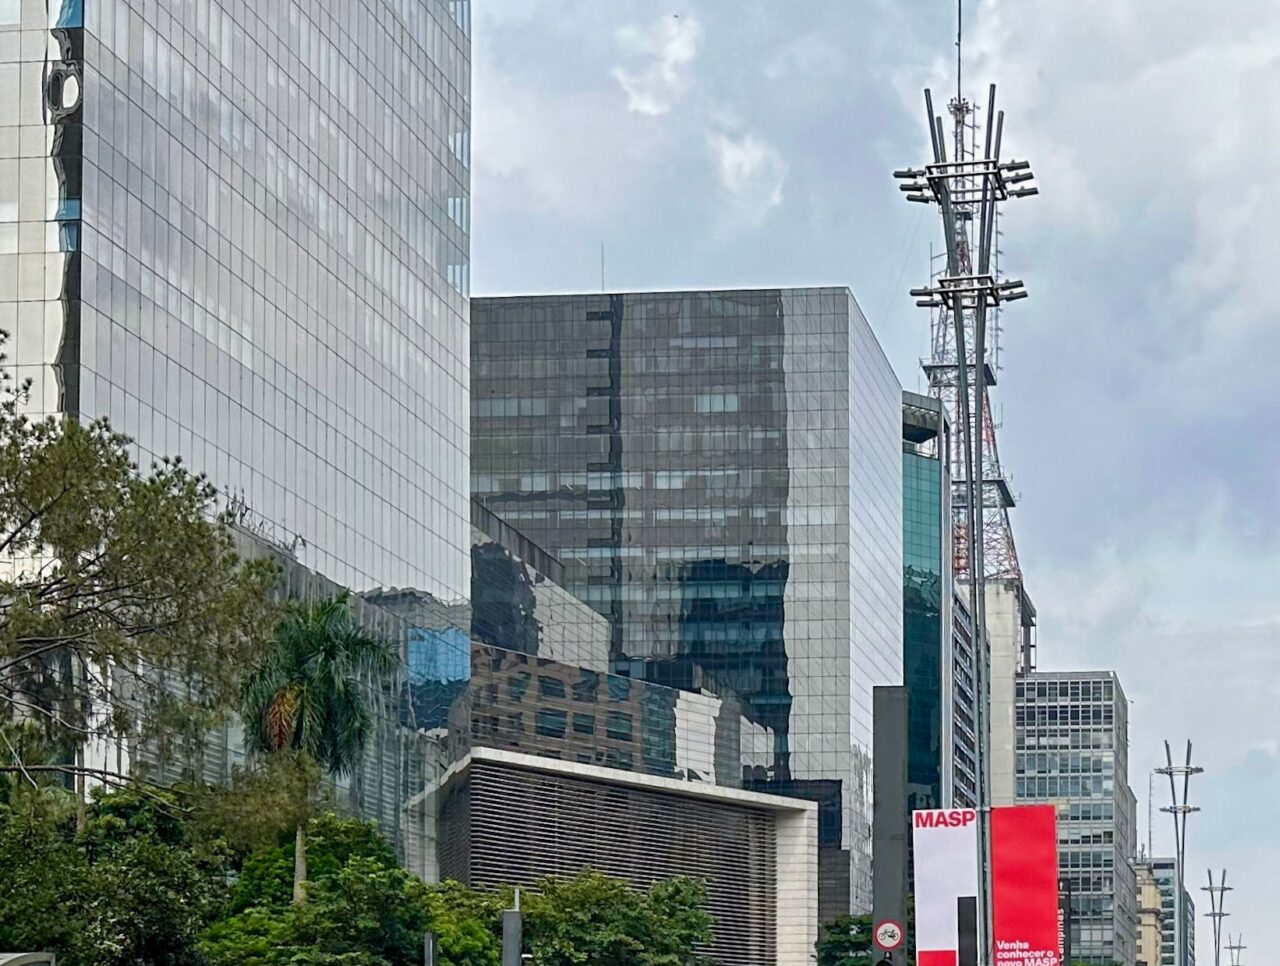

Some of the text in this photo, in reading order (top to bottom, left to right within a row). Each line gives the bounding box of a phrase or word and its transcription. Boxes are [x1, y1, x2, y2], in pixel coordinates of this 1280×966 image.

[915, 811, 975, 828] MASP
[997, 940, 1029, 950] Venha
[997, 950, 1054, 959] conhecer o
